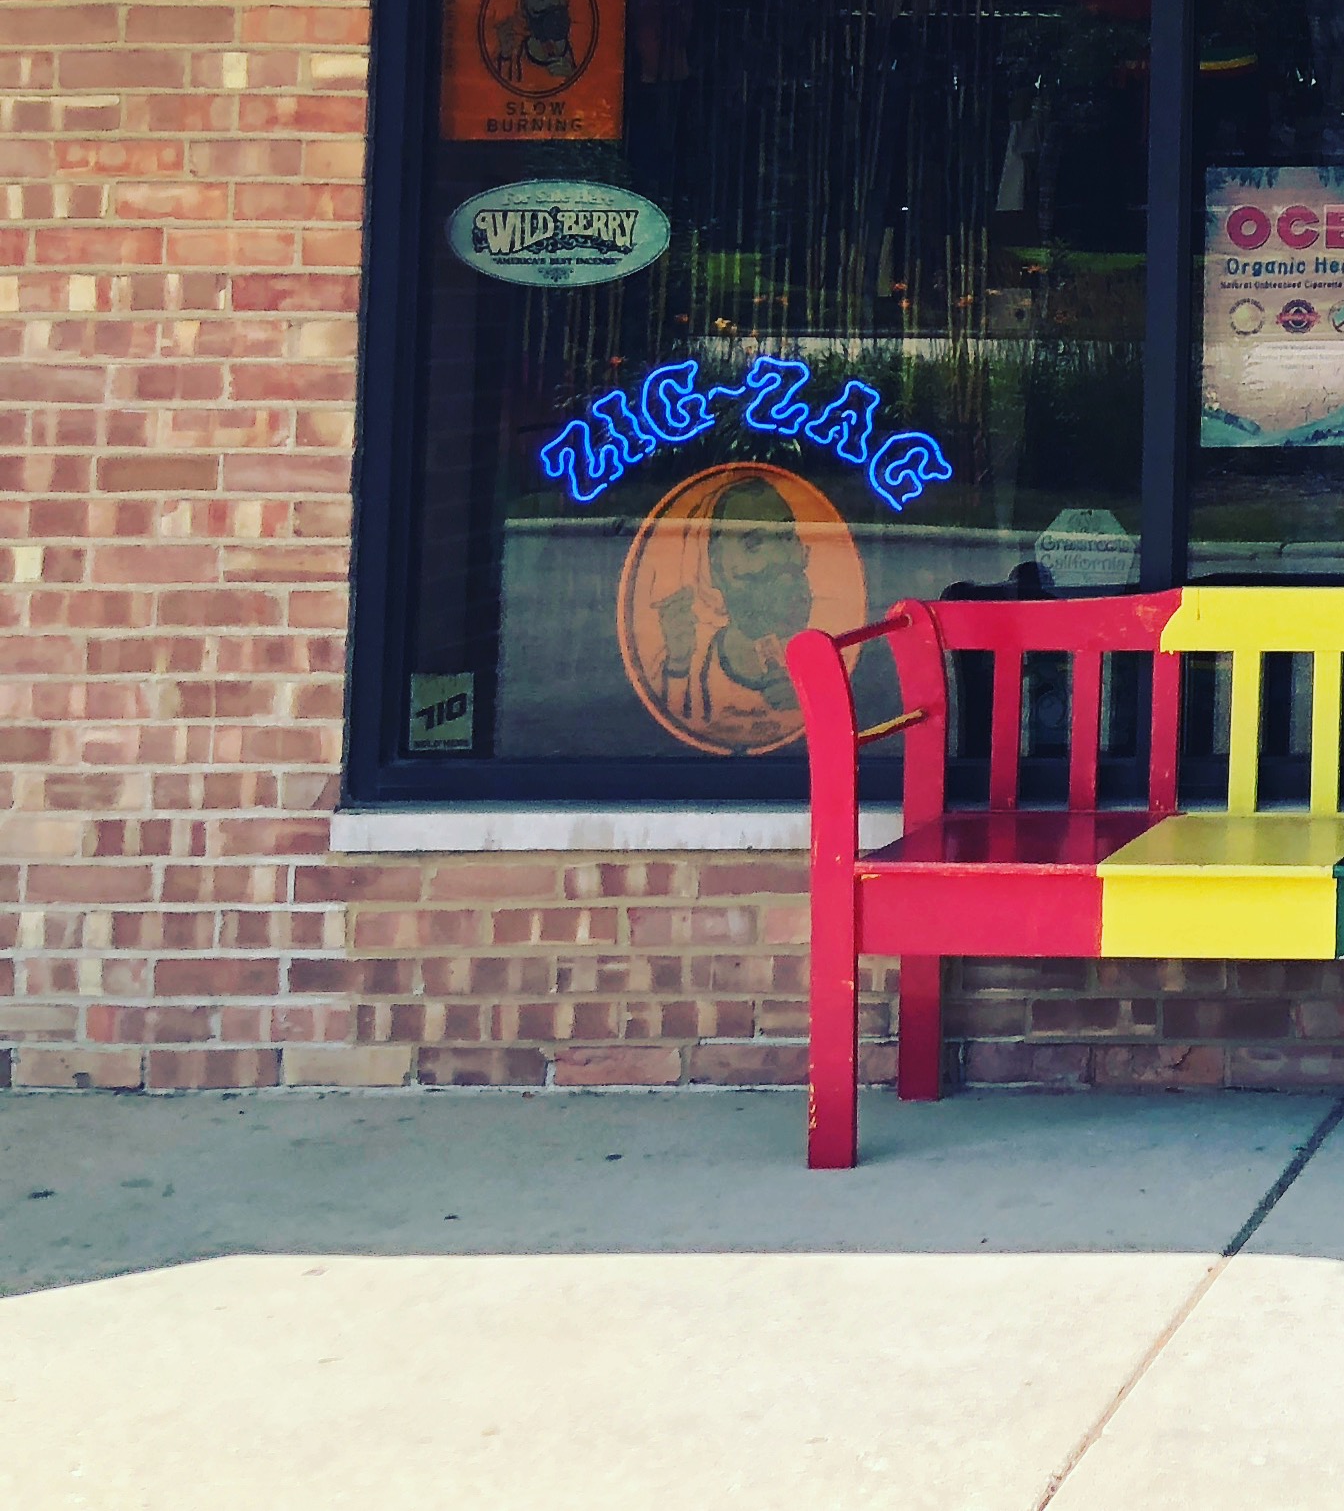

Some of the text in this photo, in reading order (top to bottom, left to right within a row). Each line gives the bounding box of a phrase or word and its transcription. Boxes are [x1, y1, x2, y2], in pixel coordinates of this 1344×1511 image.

[506, 101, 566, 116] SLOW
[487, 118, 583, 133] BURNING
[474, 211, 639, 253] WILD BERRY
[1227, 257, 1306, 277] Organic
[541, 356, 953, 511] ZIG-ZAG
[1041, 553, 1126, 571] California
